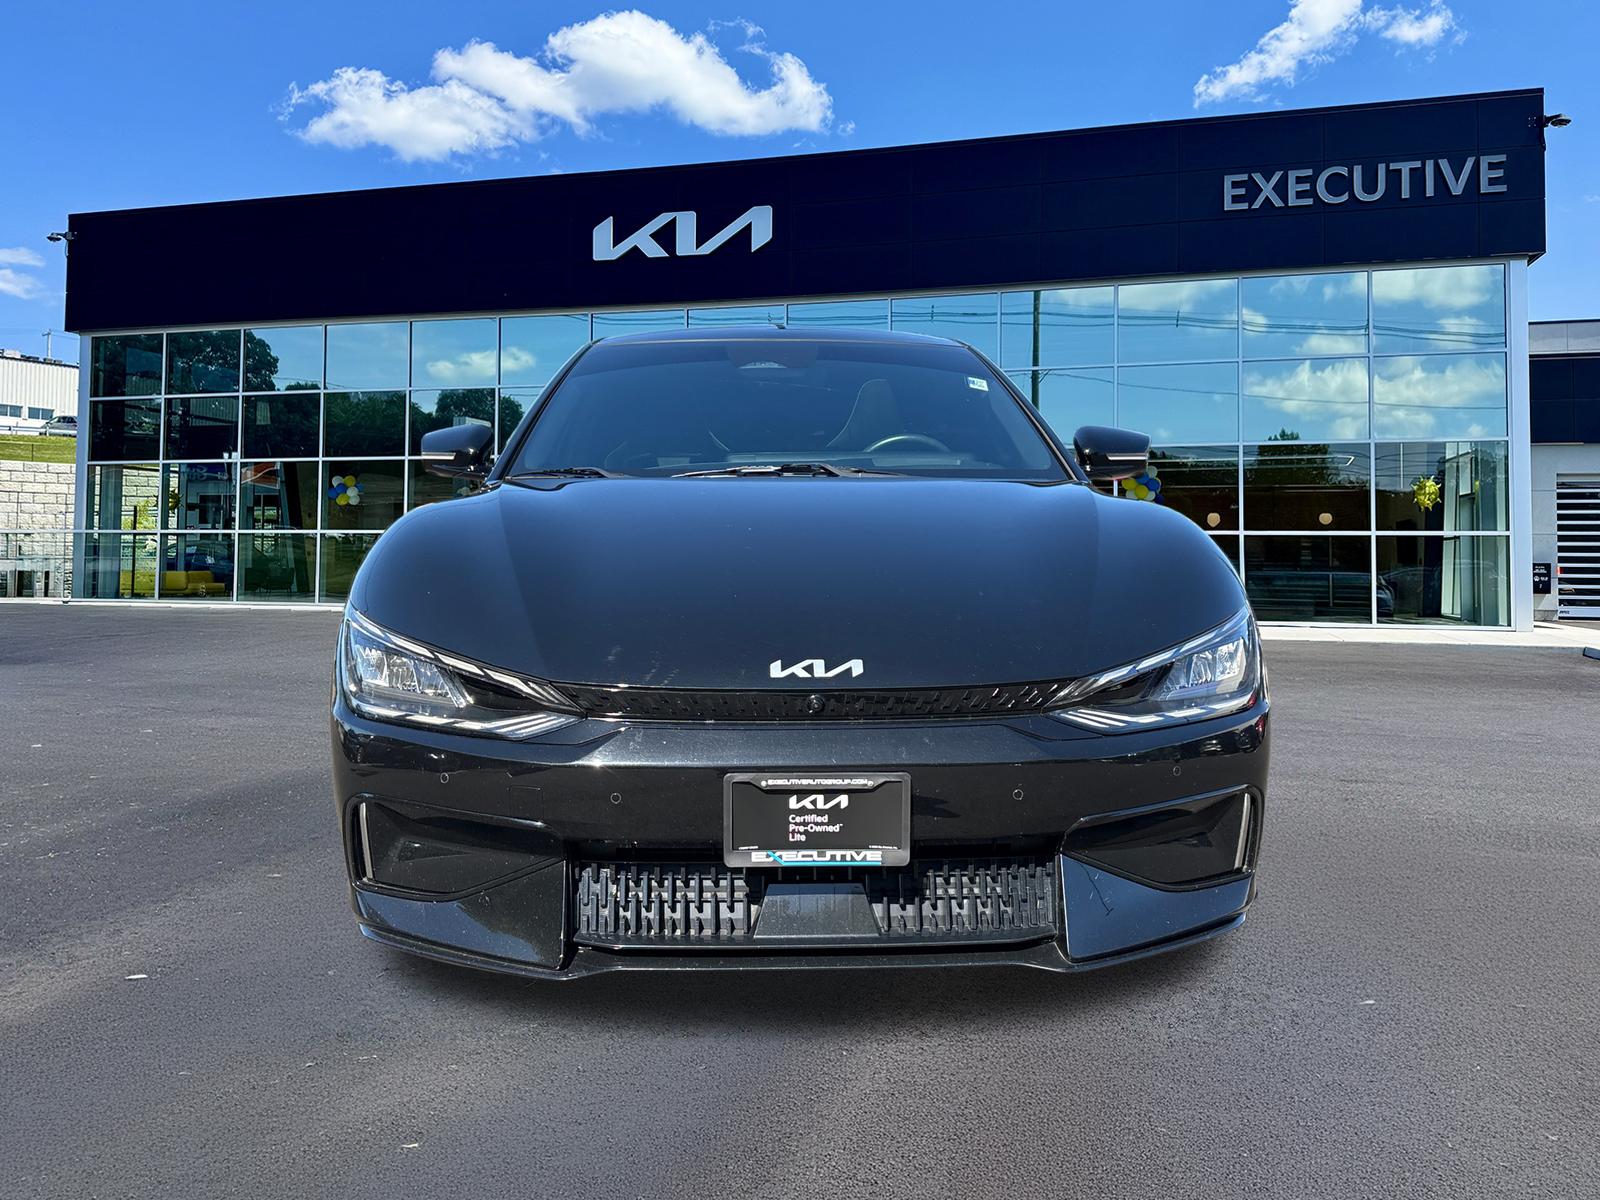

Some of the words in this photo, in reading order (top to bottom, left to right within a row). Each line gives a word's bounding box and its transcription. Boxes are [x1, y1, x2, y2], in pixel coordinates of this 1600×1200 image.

[1223, 154, 1508, 211] EXECUTIVE
[592, 205, 773, 262] KIA
[769, 659, 864, 678] KIA
[788, 794, 849, 810] KIA
[788, 814, 829, 823] Certified
[788, 833, 807, 842] Lite
[751, 850, 882, 865] EXECUTIVE
